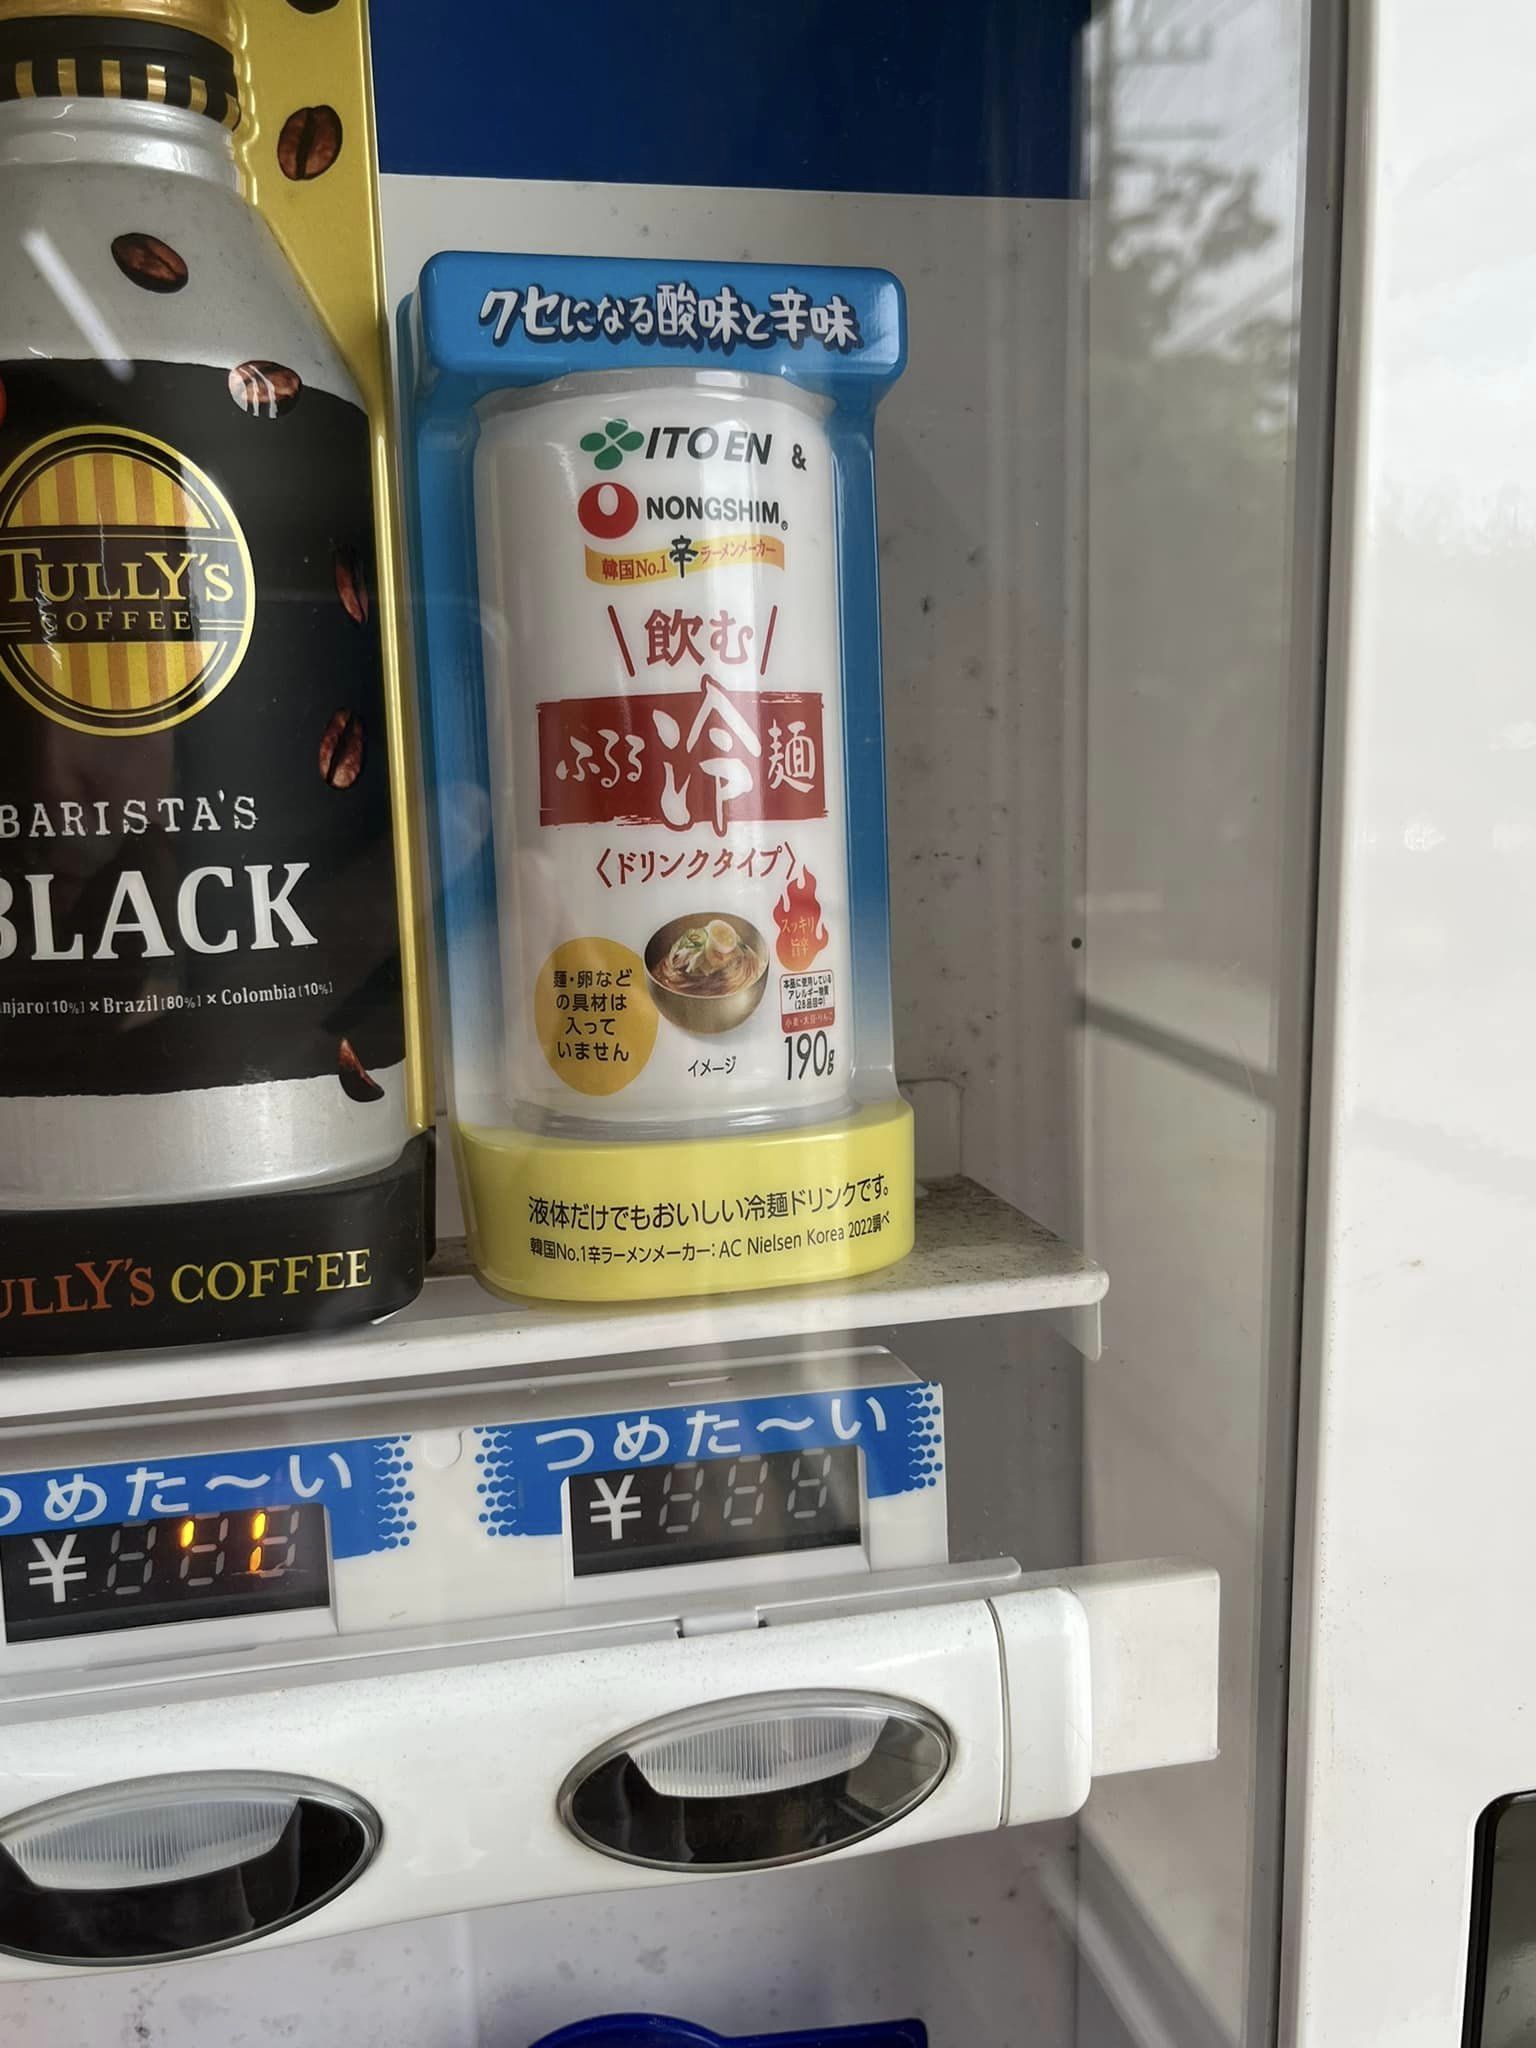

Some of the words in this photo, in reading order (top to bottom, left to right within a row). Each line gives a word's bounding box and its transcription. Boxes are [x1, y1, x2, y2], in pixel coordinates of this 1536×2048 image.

[479, 283, 858, 348] クセになる酸味と辛味
[791, 444, 807, 471] &
[0, 548, 234, 602] TULLY'S
[40, 611, 191, 632] COFFEE
[644, 609, 754, 666] 飲む
[0, 790, 257, 838] BARISTA'S
[556, 993, 628, 1012] の具材は
[565, 1016, 617, 1036] 入って
[557, 1041, 630, 1062] いません
[688, 1055, 737, 1078] イメージ
[784, 1030, 835, 1080] 190g
[528, 1173, 890, 1232] 液体だけでもおいしい冷麺ドリンクです。
[747, 1233, 802, 1254] Nielsen
[807, 1226, 845, 1247] Korea
[848, 1210, 891, 1238] 2022調べ
[171, 1248, 372, 1304] COFFEE
